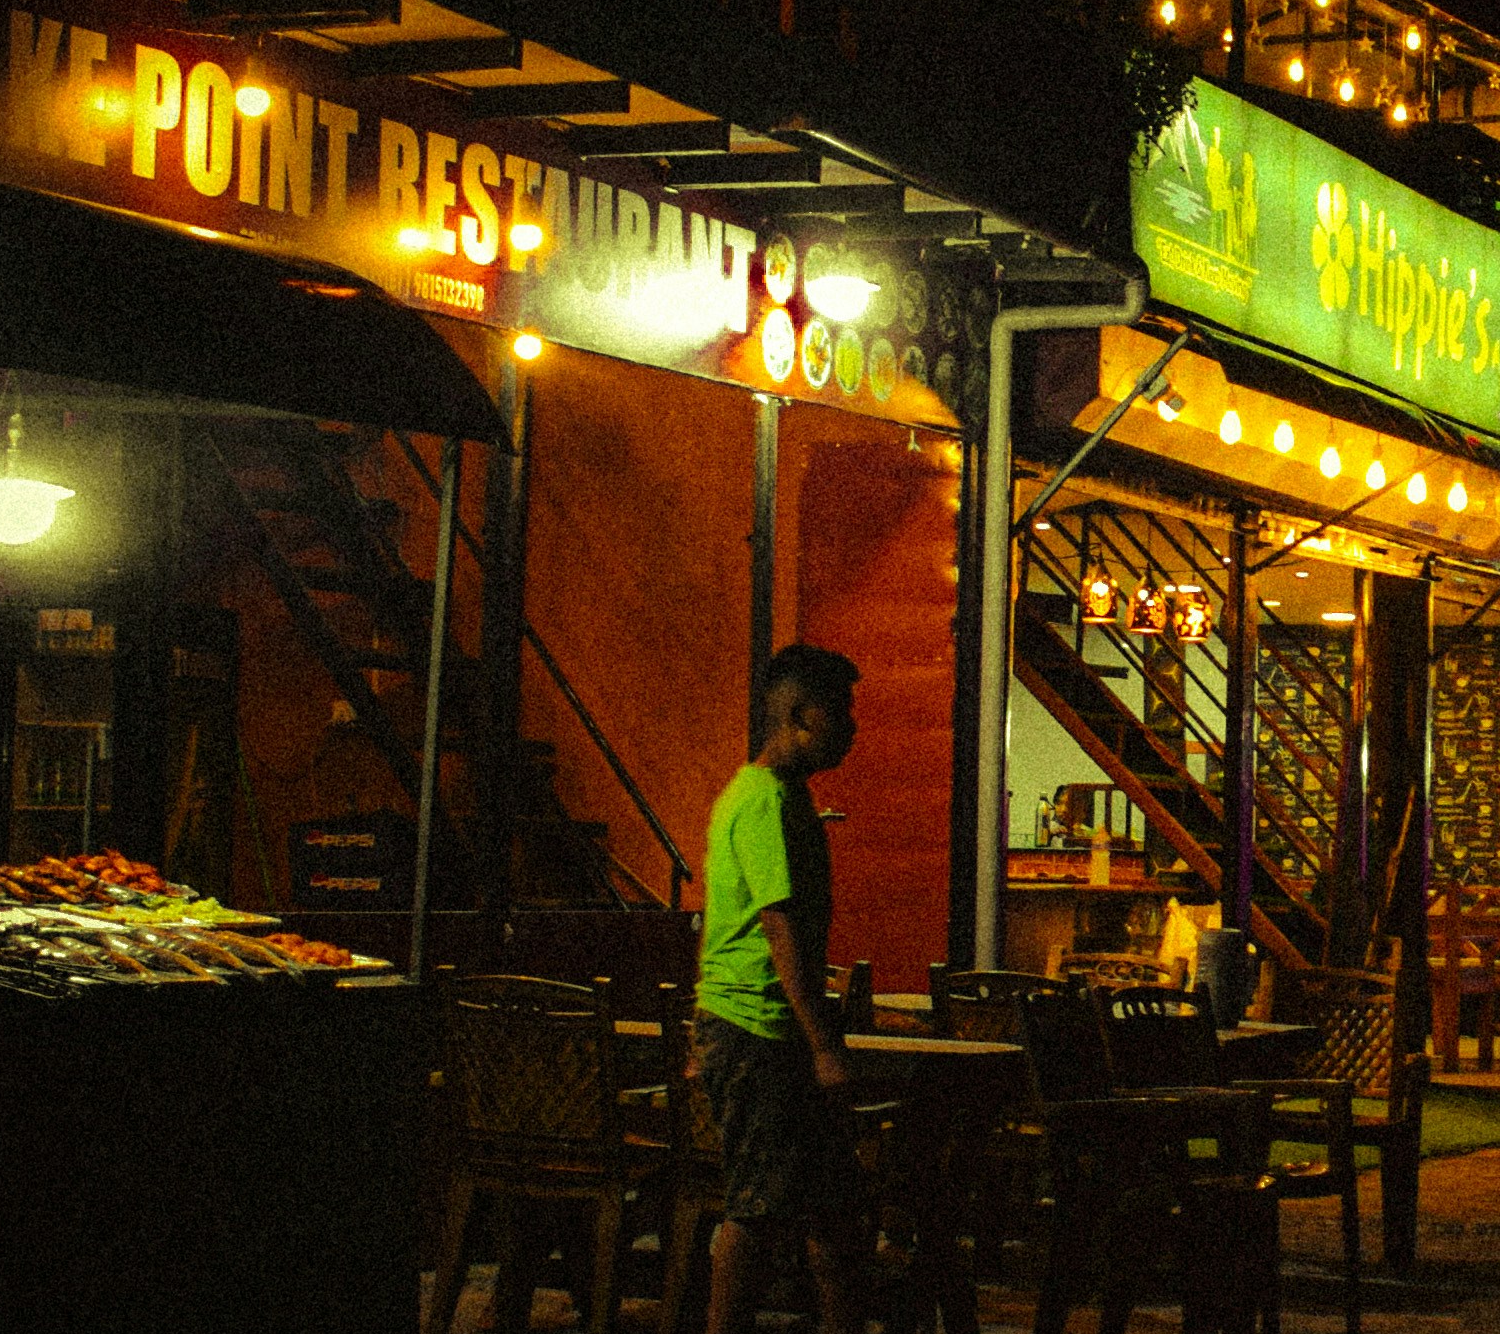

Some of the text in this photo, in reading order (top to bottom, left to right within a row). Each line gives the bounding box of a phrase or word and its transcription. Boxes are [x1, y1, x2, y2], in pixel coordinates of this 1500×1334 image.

[131, 42, 359, 227] POINT
[378, 117, 757, 333] RESTAURANT
[1358, 200, 1492, 381] Hippie's
